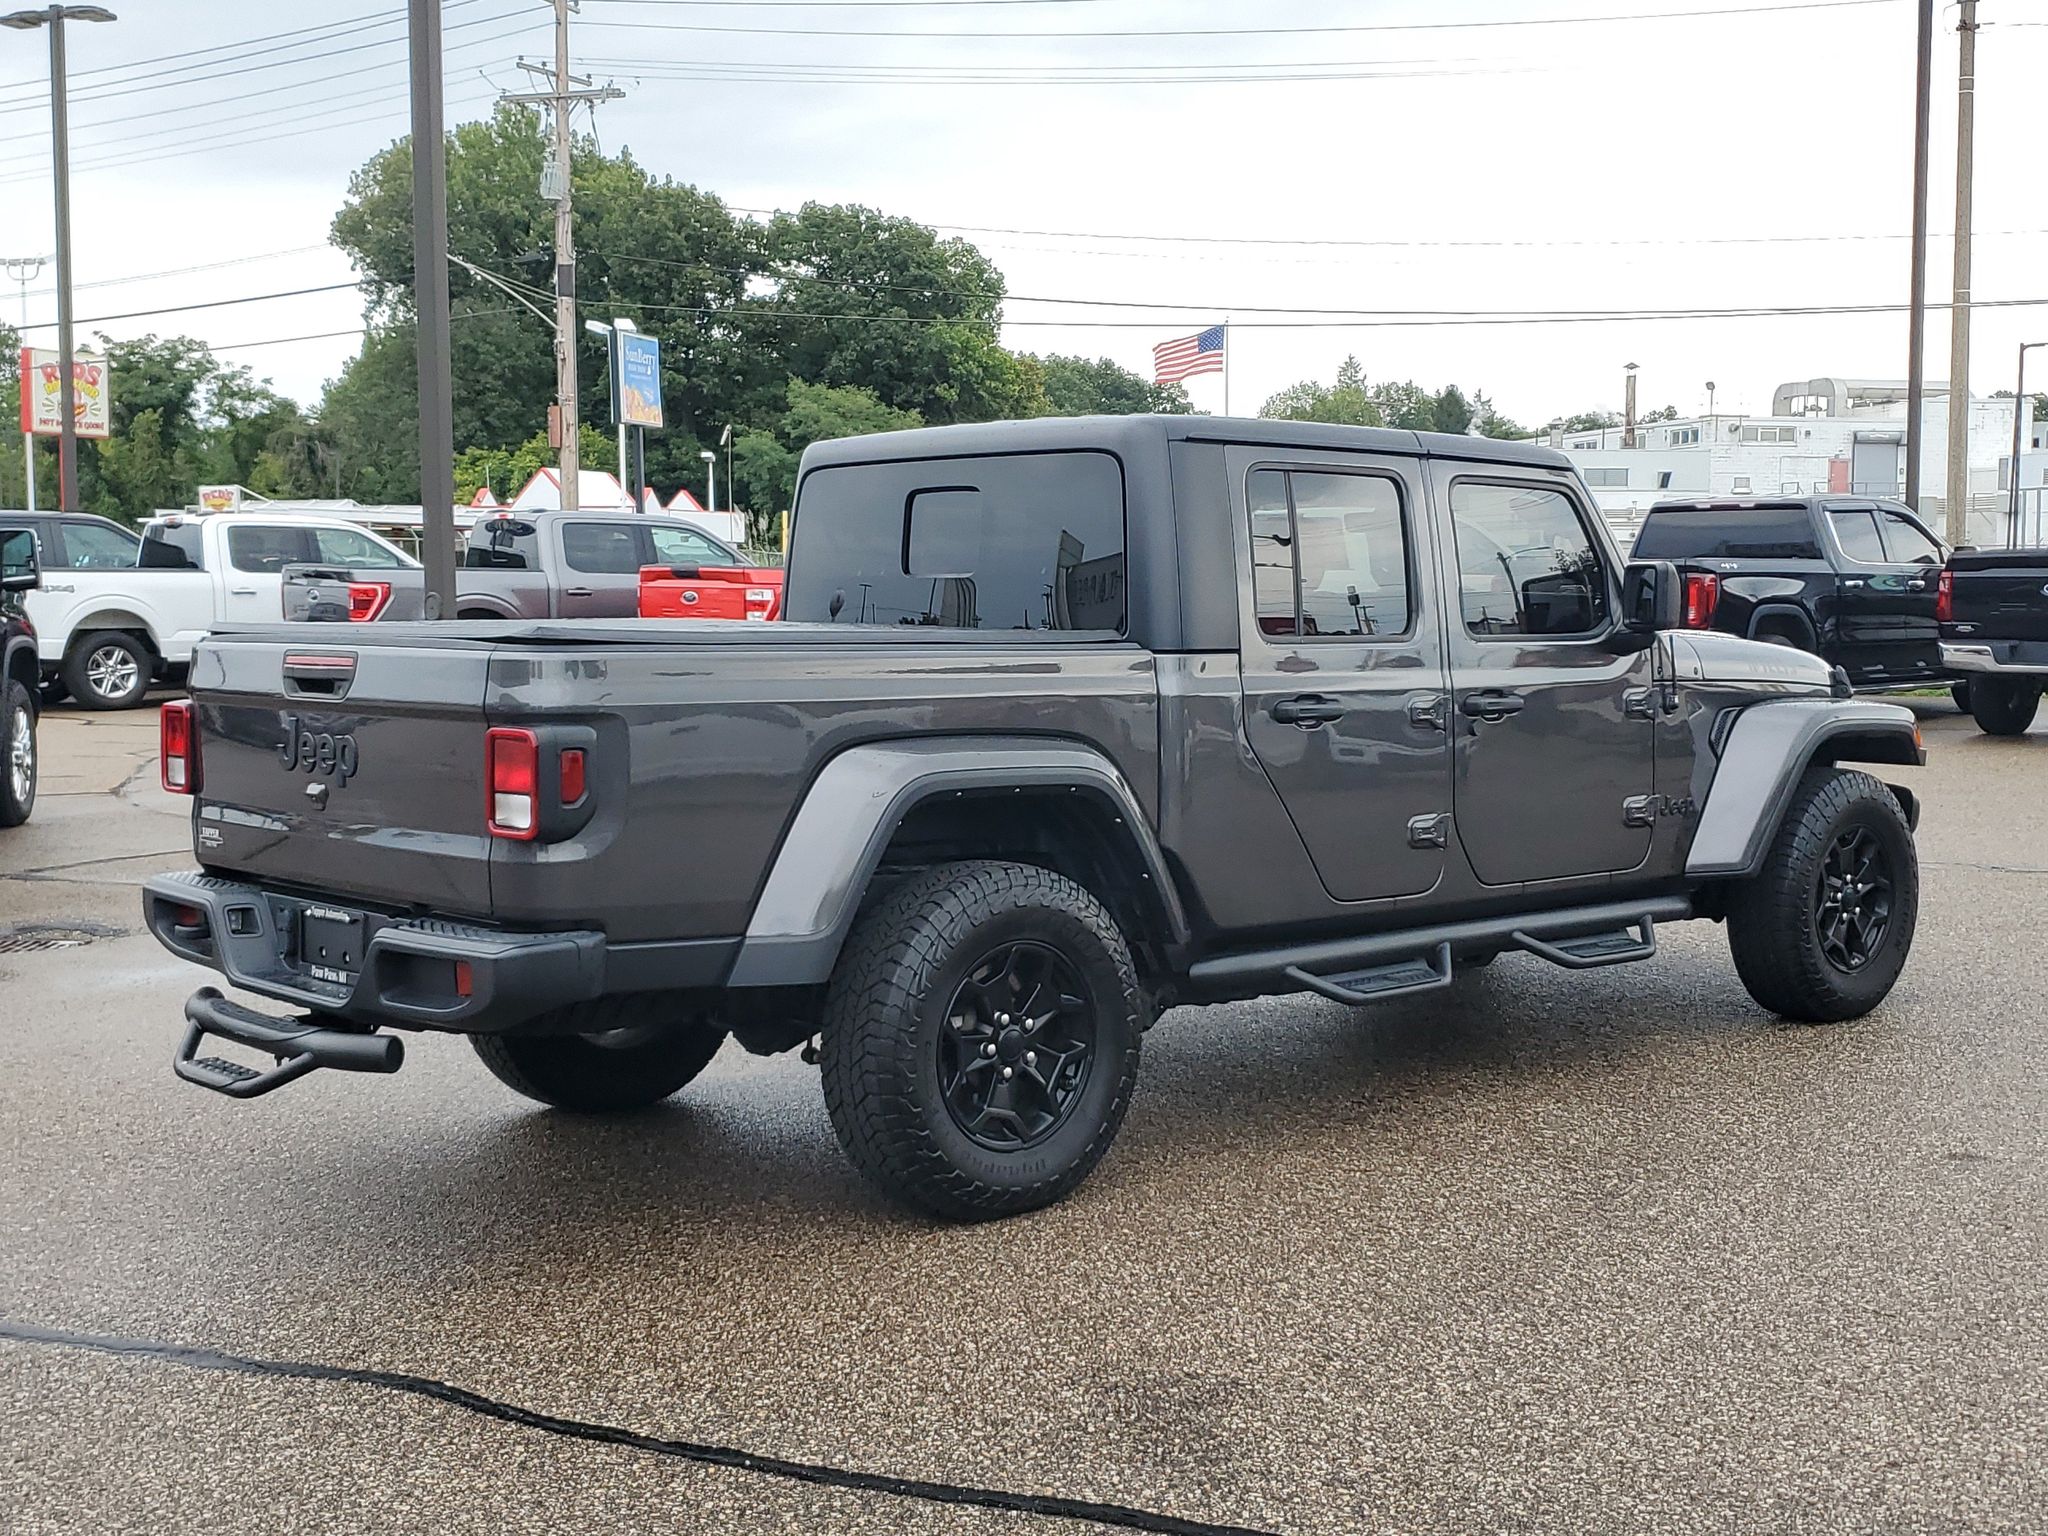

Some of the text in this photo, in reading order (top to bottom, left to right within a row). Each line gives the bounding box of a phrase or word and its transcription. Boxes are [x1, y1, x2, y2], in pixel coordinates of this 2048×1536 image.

[625, 345, 656, 370] SunBerry
[40, 362, 102, 386] RDS
[275, 716, 359, 788] Jeep
